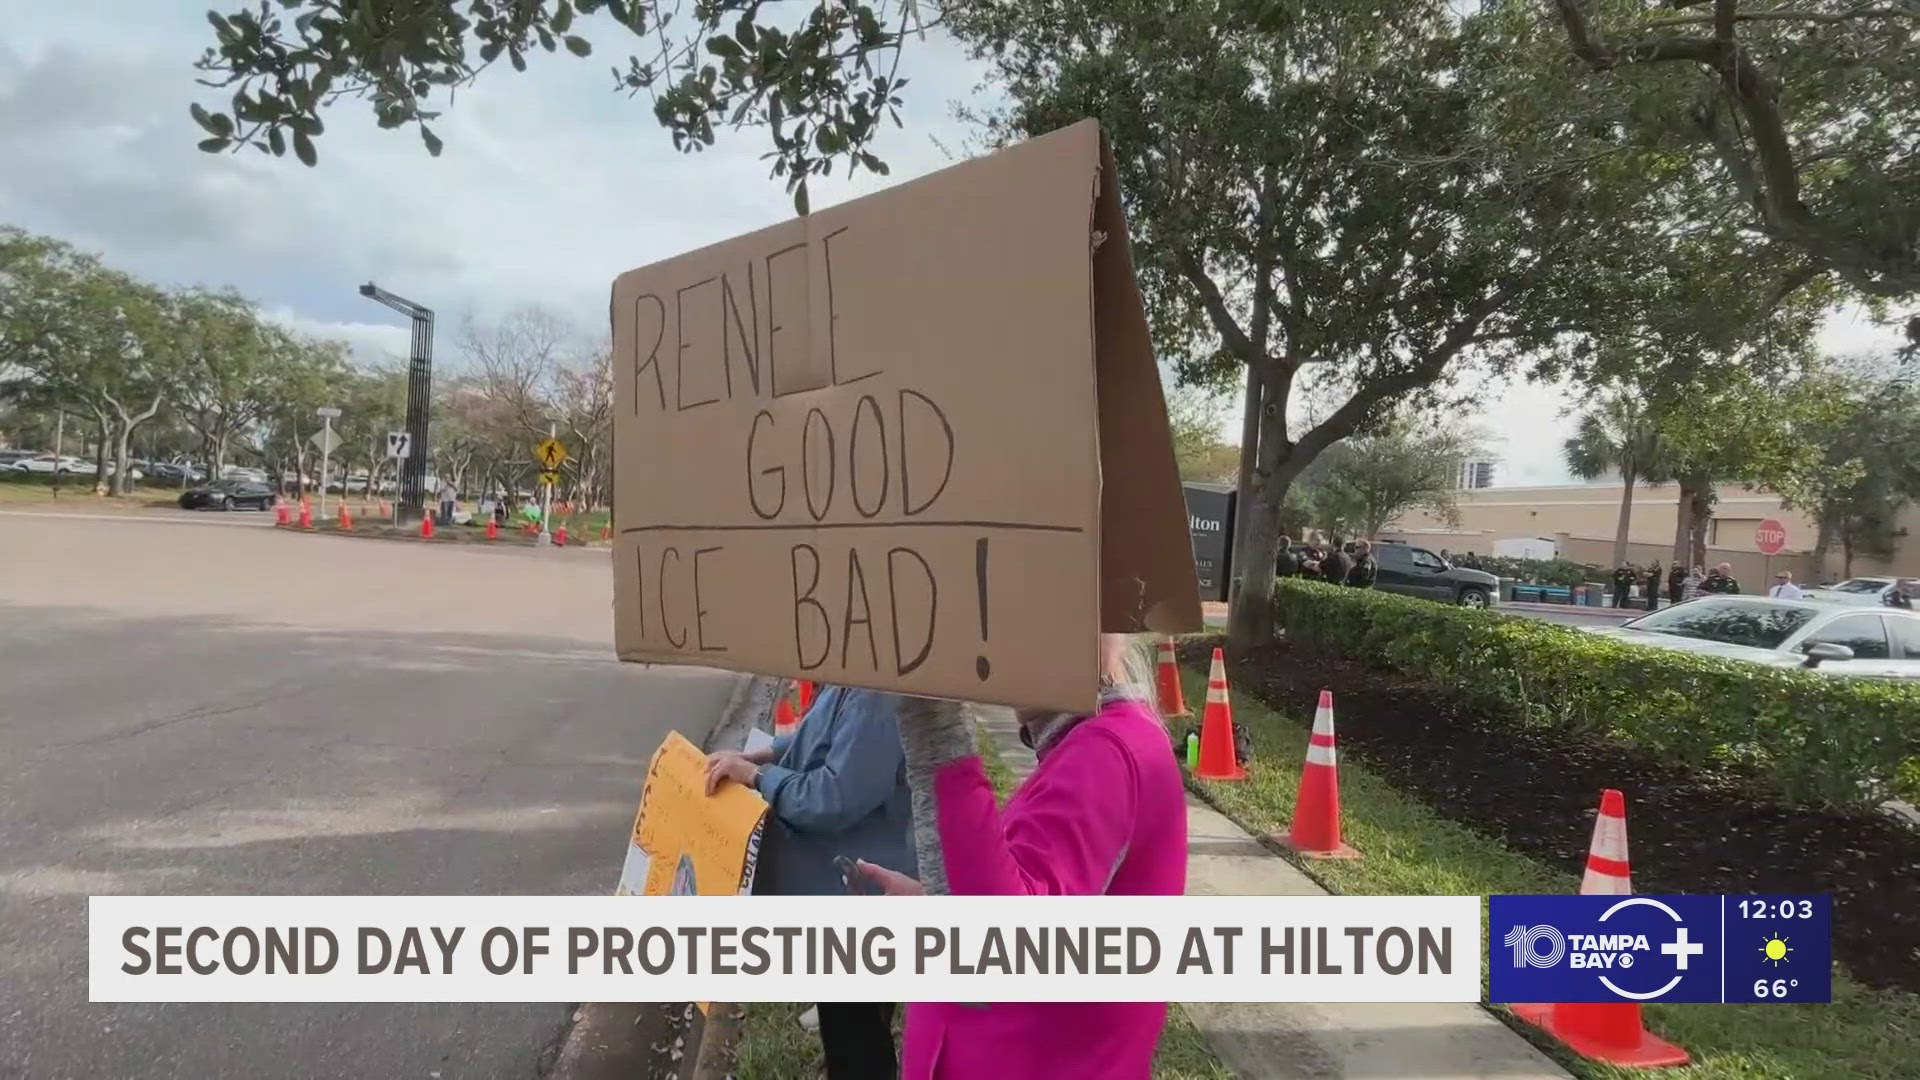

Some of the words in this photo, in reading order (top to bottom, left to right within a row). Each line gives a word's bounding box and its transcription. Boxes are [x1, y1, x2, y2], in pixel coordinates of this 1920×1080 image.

[633, 226, 884, 416] RENEE
[746, 388, 955, 522] GOOD
[1190, 514, 1220, 531] lton
[1757, 529, 1784, 544] STOP
[637, 545, 728, 652] ICE
